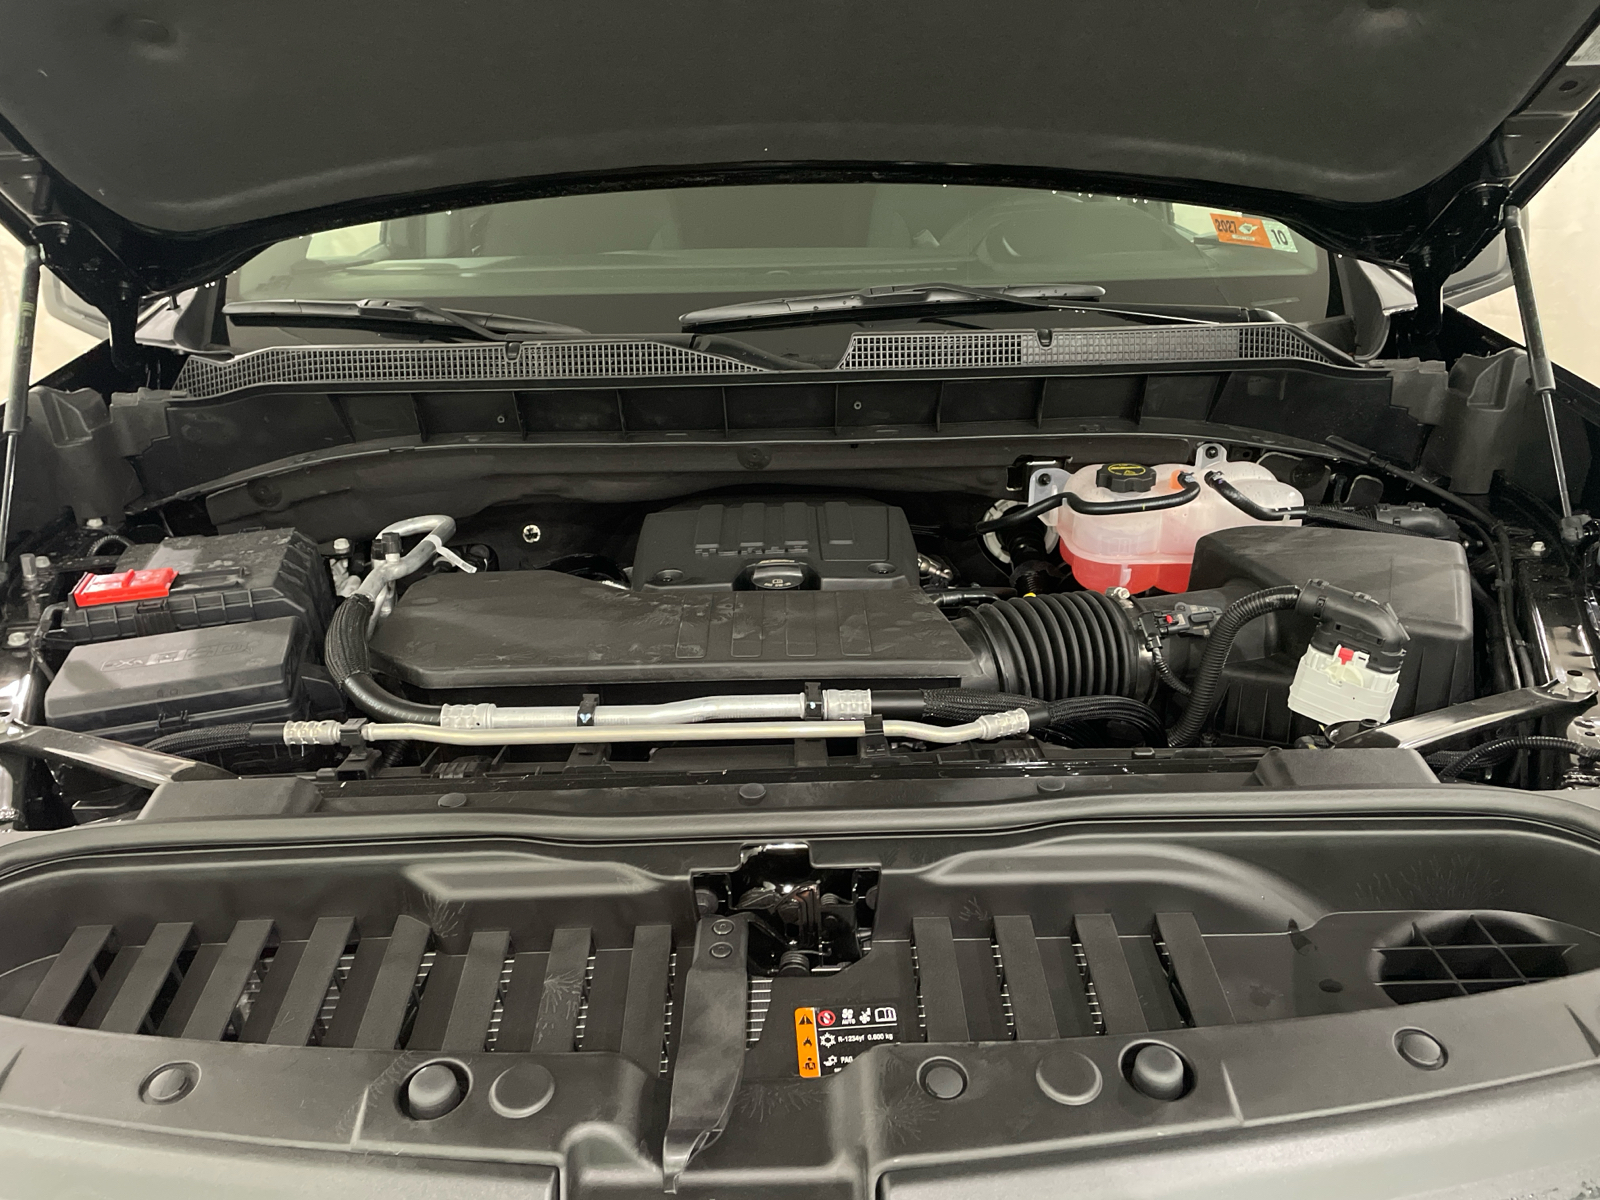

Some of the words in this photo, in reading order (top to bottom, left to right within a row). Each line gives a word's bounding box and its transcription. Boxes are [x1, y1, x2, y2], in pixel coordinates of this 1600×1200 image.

[1215, 219, 1237, 234] 2027
[1271, 229, 1288, 245] 10
[838, 1034, 865, 1042] R-1234yf
[885, 1033, 893, 1041] kg
